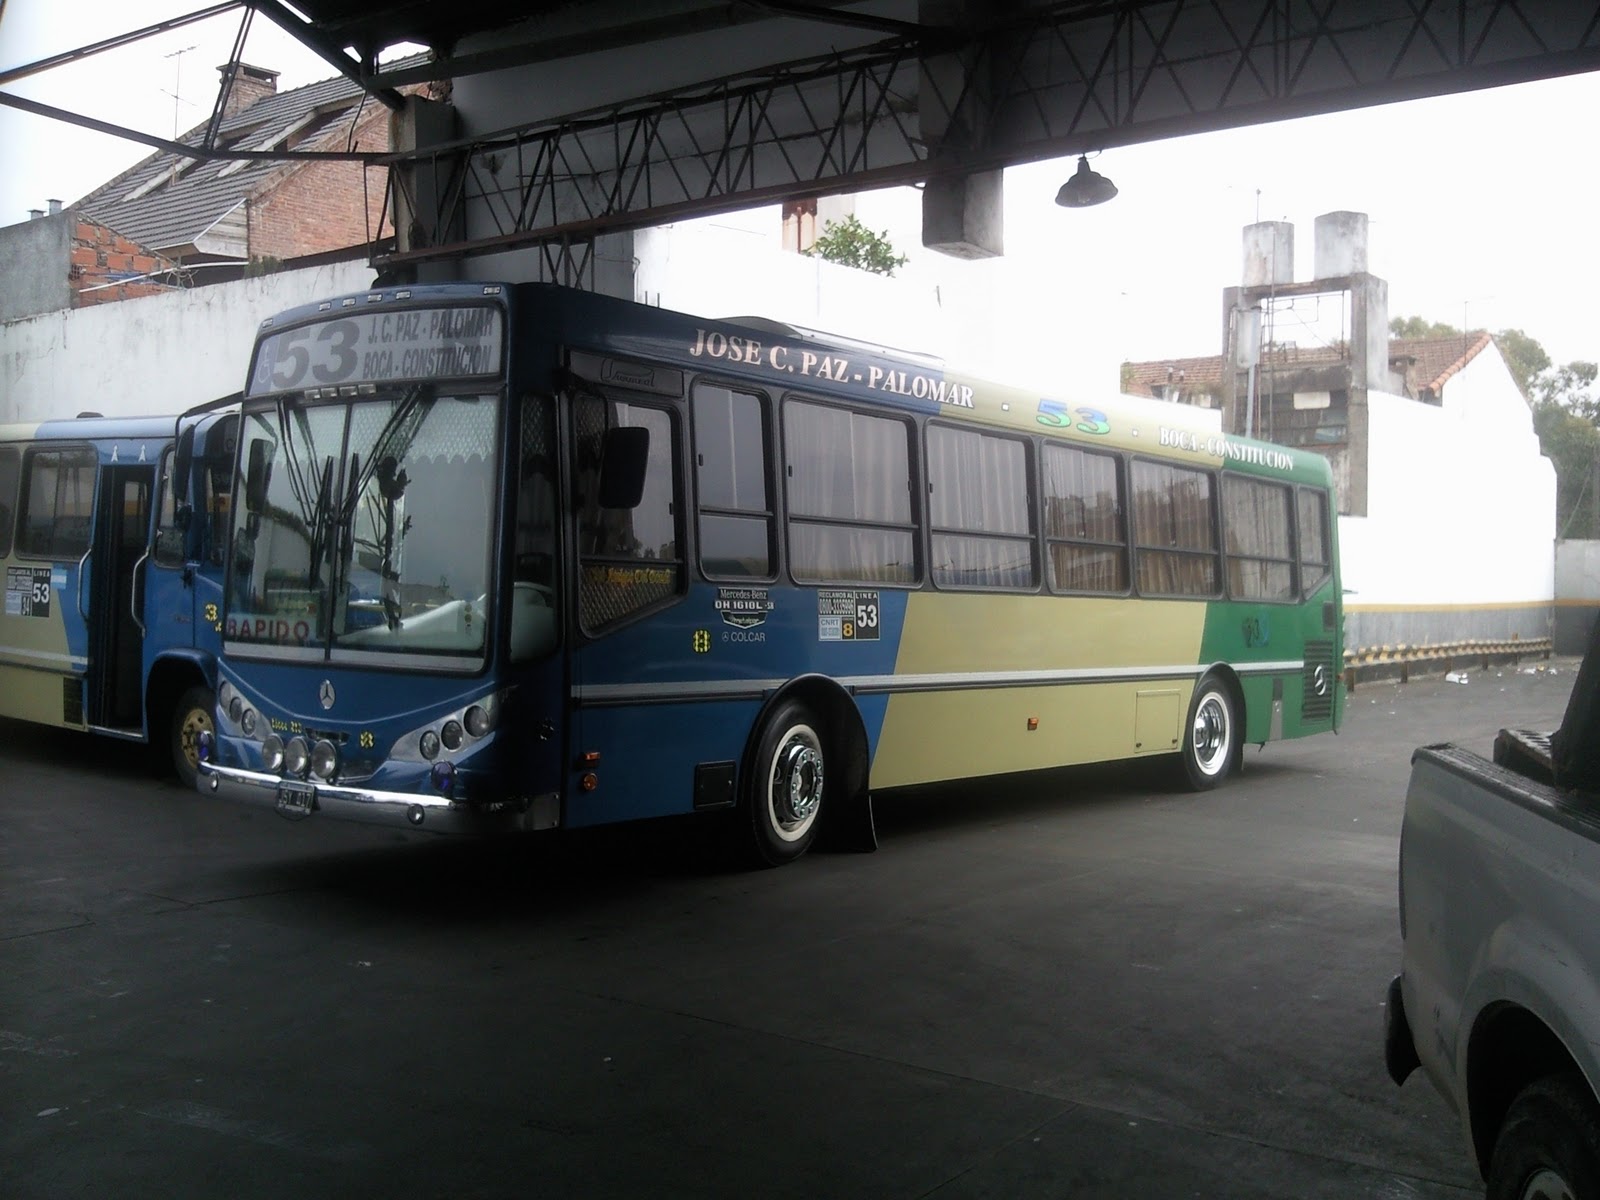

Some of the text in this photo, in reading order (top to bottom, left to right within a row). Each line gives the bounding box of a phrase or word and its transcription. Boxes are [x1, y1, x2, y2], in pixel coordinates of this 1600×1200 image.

[394, 312, 420, 342] PAZ
[428, 308, 493, 341] PALOMAR
[272, 320, 360, 388] 53
[363, 352, 394, 379] BOCA
[401, 346, 492, 377] CONSTITUCION
[690, 328, 762, 365] JOSE
[769, 345, 794, 373] C.
[801, 351, 849, 383] PAZ
[868, 366, 975, 408] PALOMAR
[1036, 398, 1110, 435] 53
[1159, 426, 1198, 452] BOCA
[1207, 438, 1293, 470] CONSTITUCION
[33, 583, 49, 603] 53
[720, 589, 767, 599] Mercedes-Benz
[857, 604, 877, 628] 53
[227, 618, 310, 640] RAPIDO
[730, 631, 766, 642] COLCAR
[843, 623, 853, 637] 8
